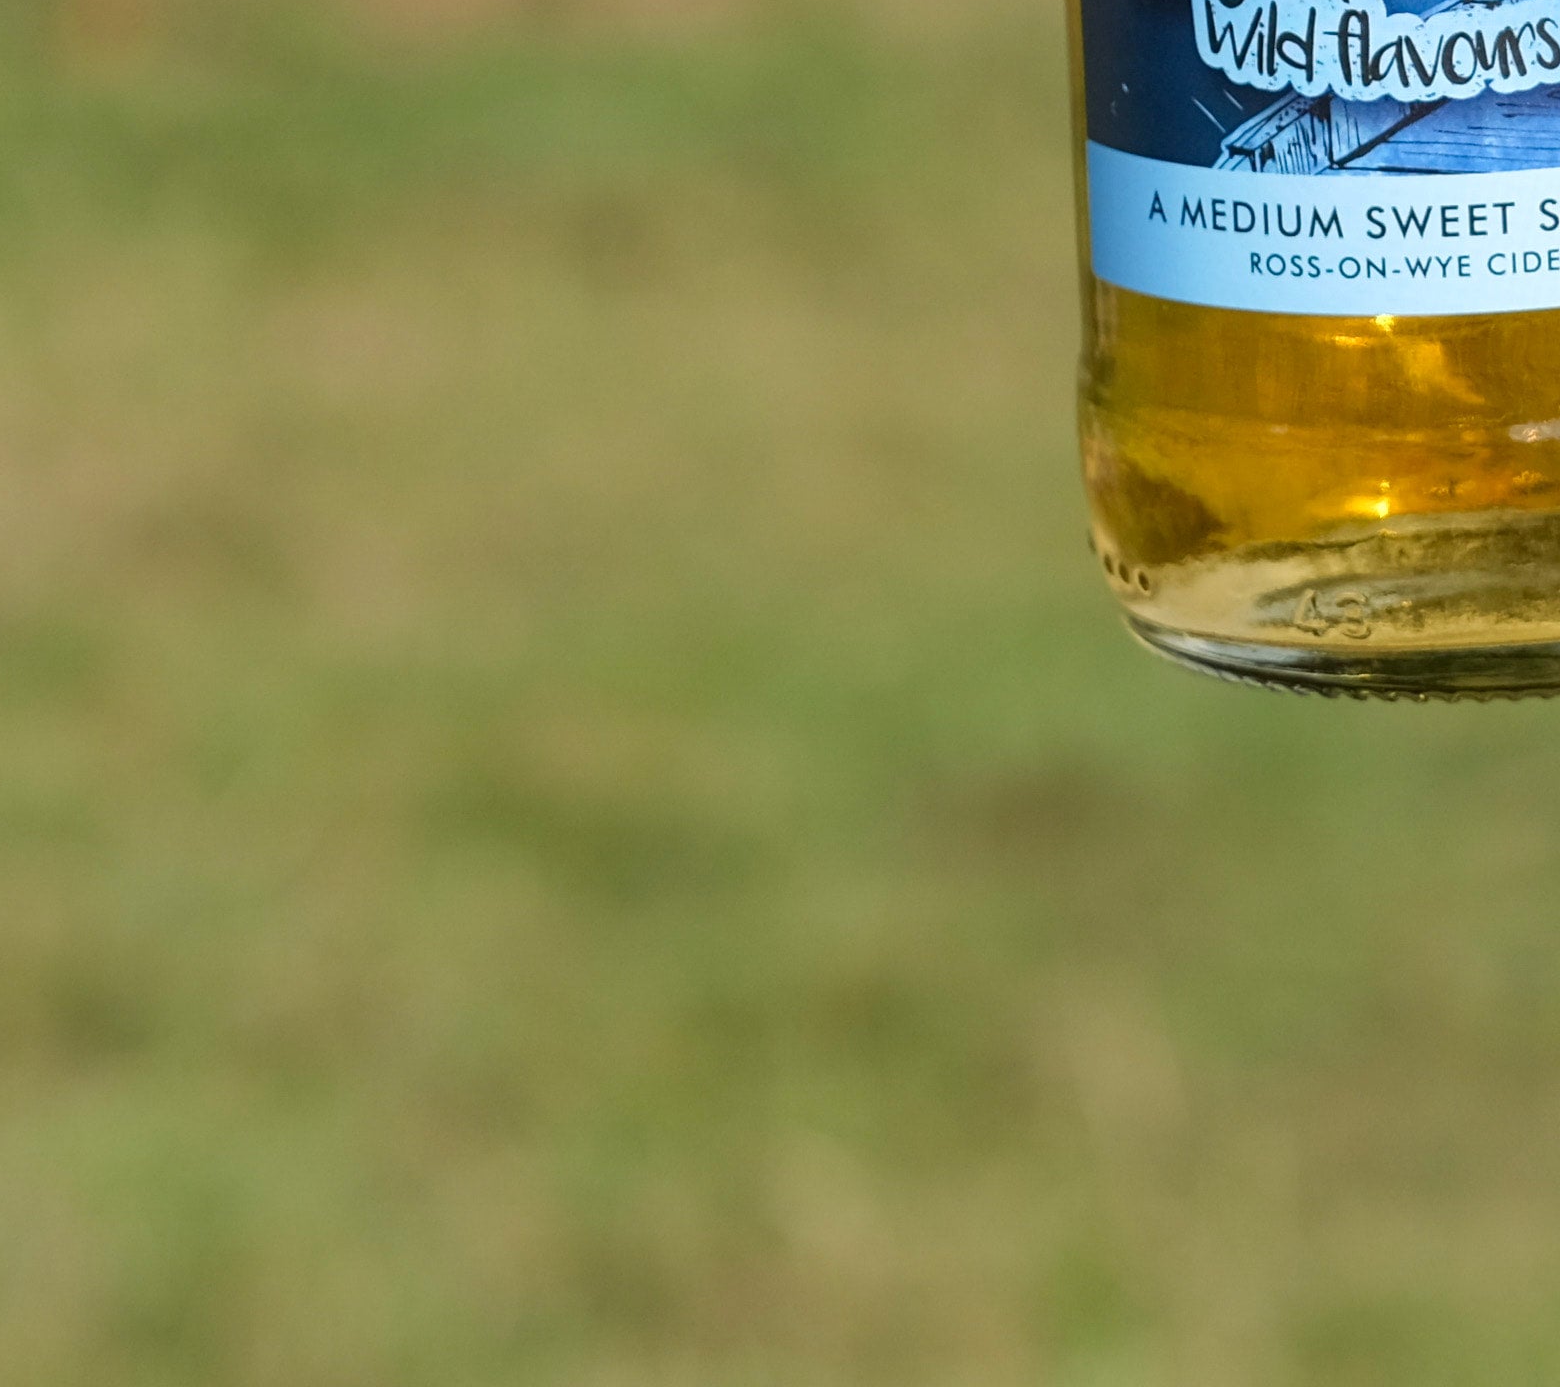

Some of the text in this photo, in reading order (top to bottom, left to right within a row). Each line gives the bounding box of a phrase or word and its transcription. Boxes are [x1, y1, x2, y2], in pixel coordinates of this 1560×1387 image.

[1148, 190, 1168, 224] A
[1180, 195, 1344, 239] MEDIUM
[1366, 201, 1516, 239] SWEET
[1250, 252, 1472, 280] ROSS-ON-WYE
